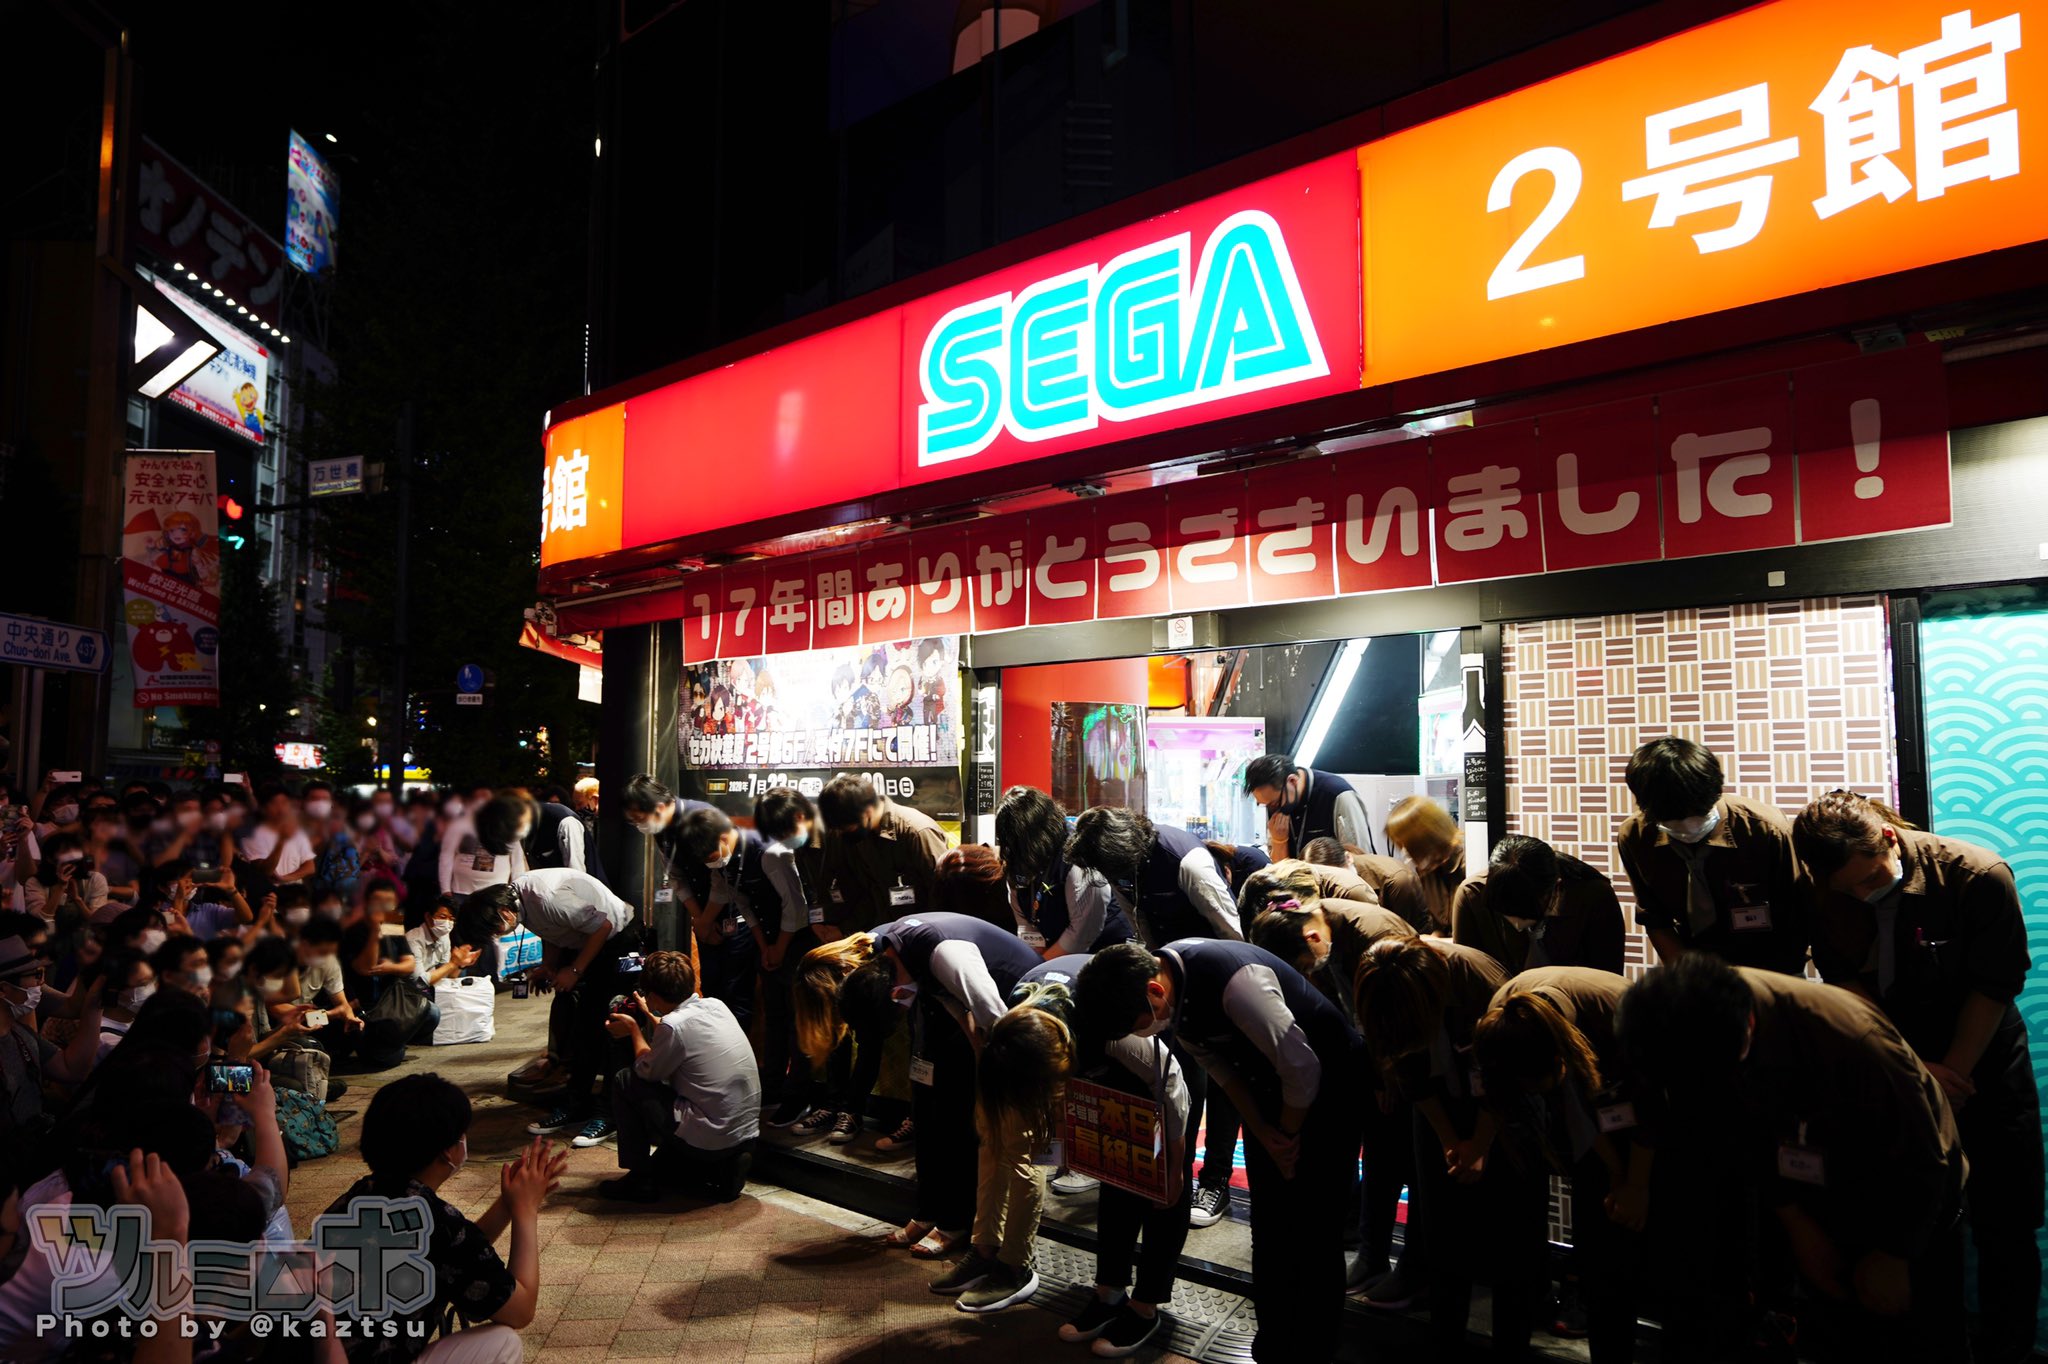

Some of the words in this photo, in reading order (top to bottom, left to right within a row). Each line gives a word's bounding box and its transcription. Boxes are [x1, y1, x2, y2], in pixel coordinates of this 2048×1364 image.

[1486, 9, 2021, 301] 2号館
[918, 209, 1331, 467] SEGA
[140, 459, 203, 471] みんなで協力
[313, 463, 358, 482] 万世橋
[128, 490, 214, 506] 元気なアキバ
[127, 576, 167, 598] Welcome
[7, 621, 70, 648] 中央通り
[3, 641, 52, 660] Chuo-dori
[150, 692, 163, 701] No
[164, 692, 203, 703] Smoking
